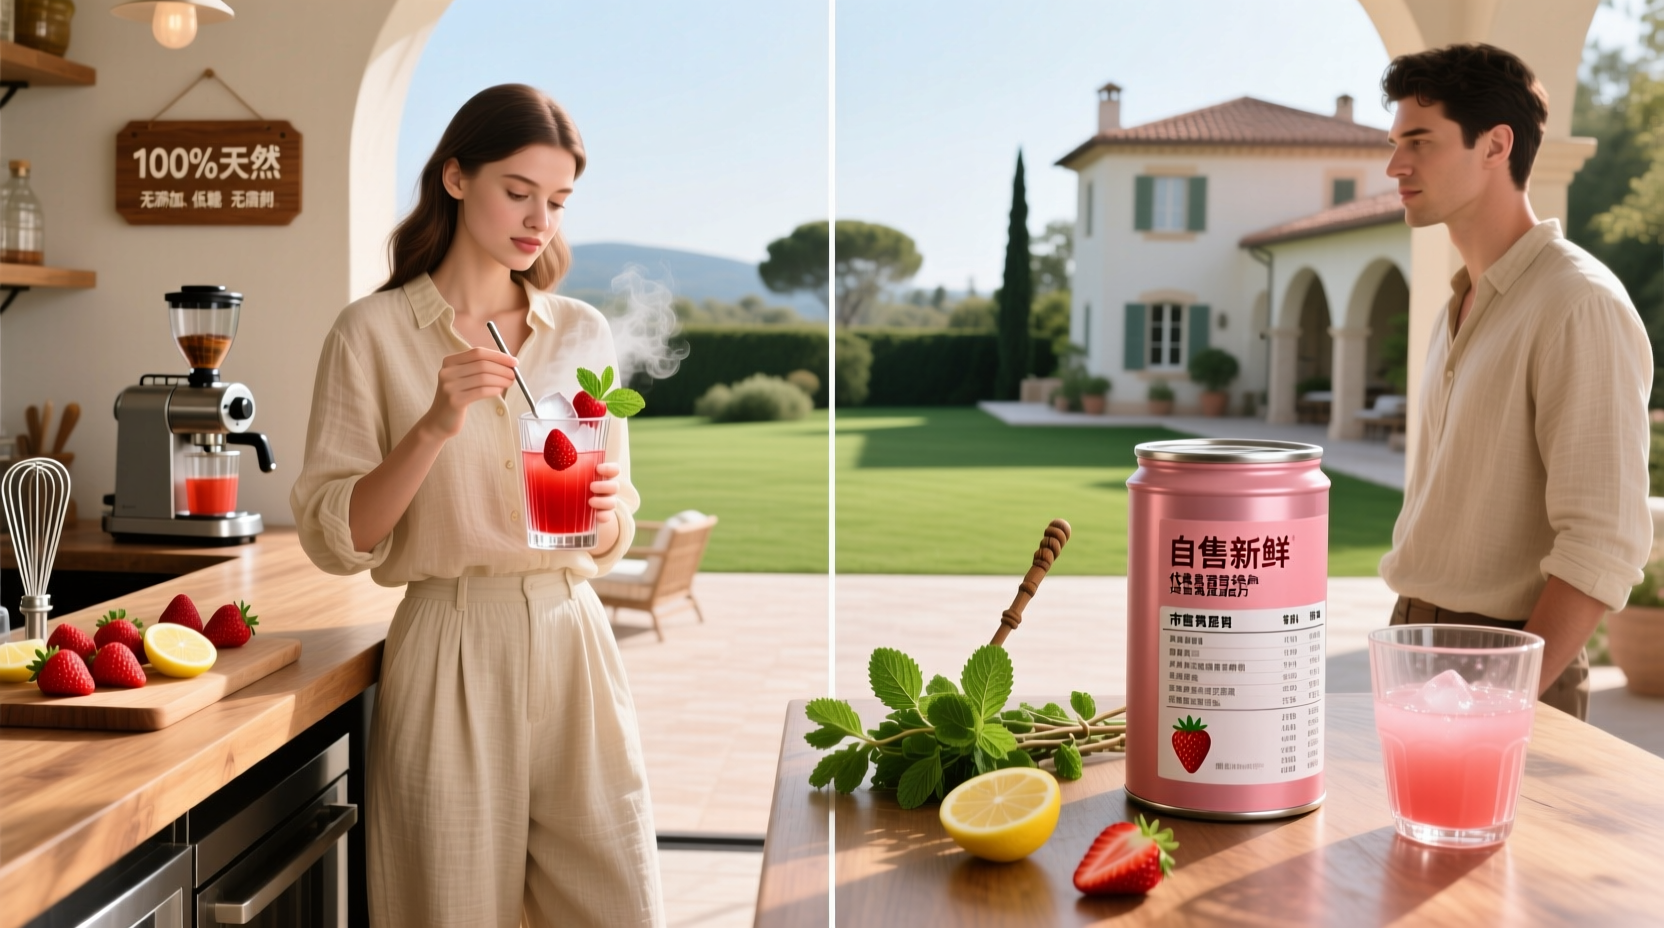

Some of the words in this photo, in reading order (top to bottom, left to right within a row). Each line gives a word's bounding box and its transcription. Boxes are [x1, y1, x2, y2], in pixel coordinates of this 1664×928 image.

[133, 144, 281, 180] 100%天然
[1171, 534, 1290, 569] 自售新鲜
